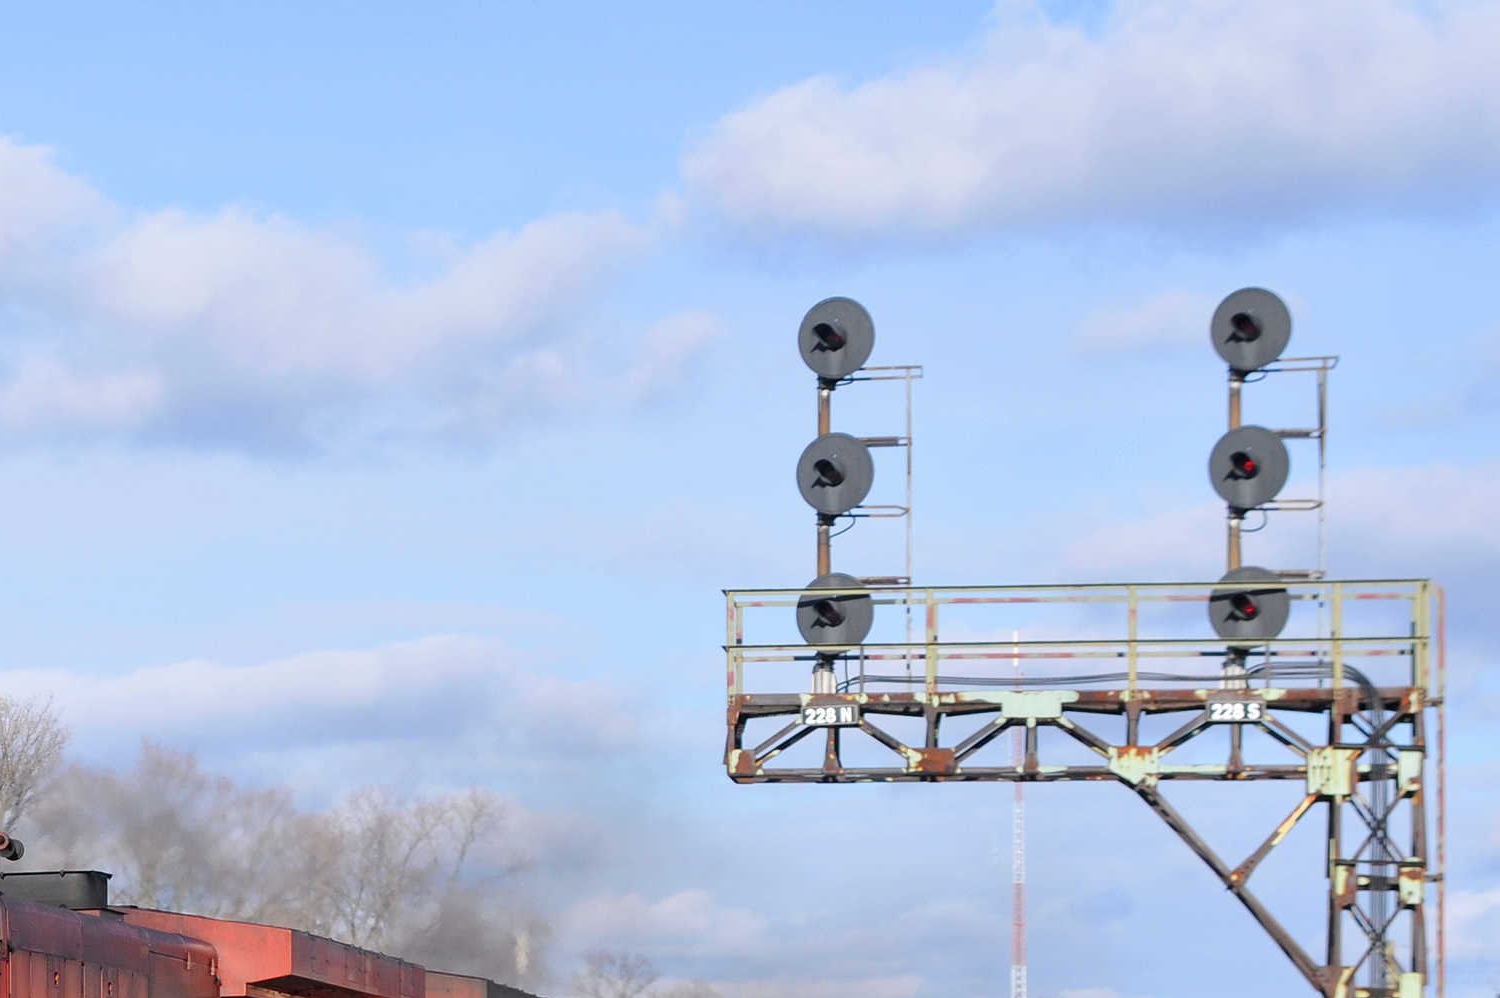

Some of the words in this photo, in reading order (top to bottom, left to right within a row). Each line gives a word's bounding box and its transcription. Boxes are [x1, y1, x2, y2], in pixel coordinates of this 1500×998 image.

[805, 707, 837, 724] 228
[840, 706, 852, 723] N
[1211, 703, 1245, 720] 228
[1247, 702, 1261, 720] S
